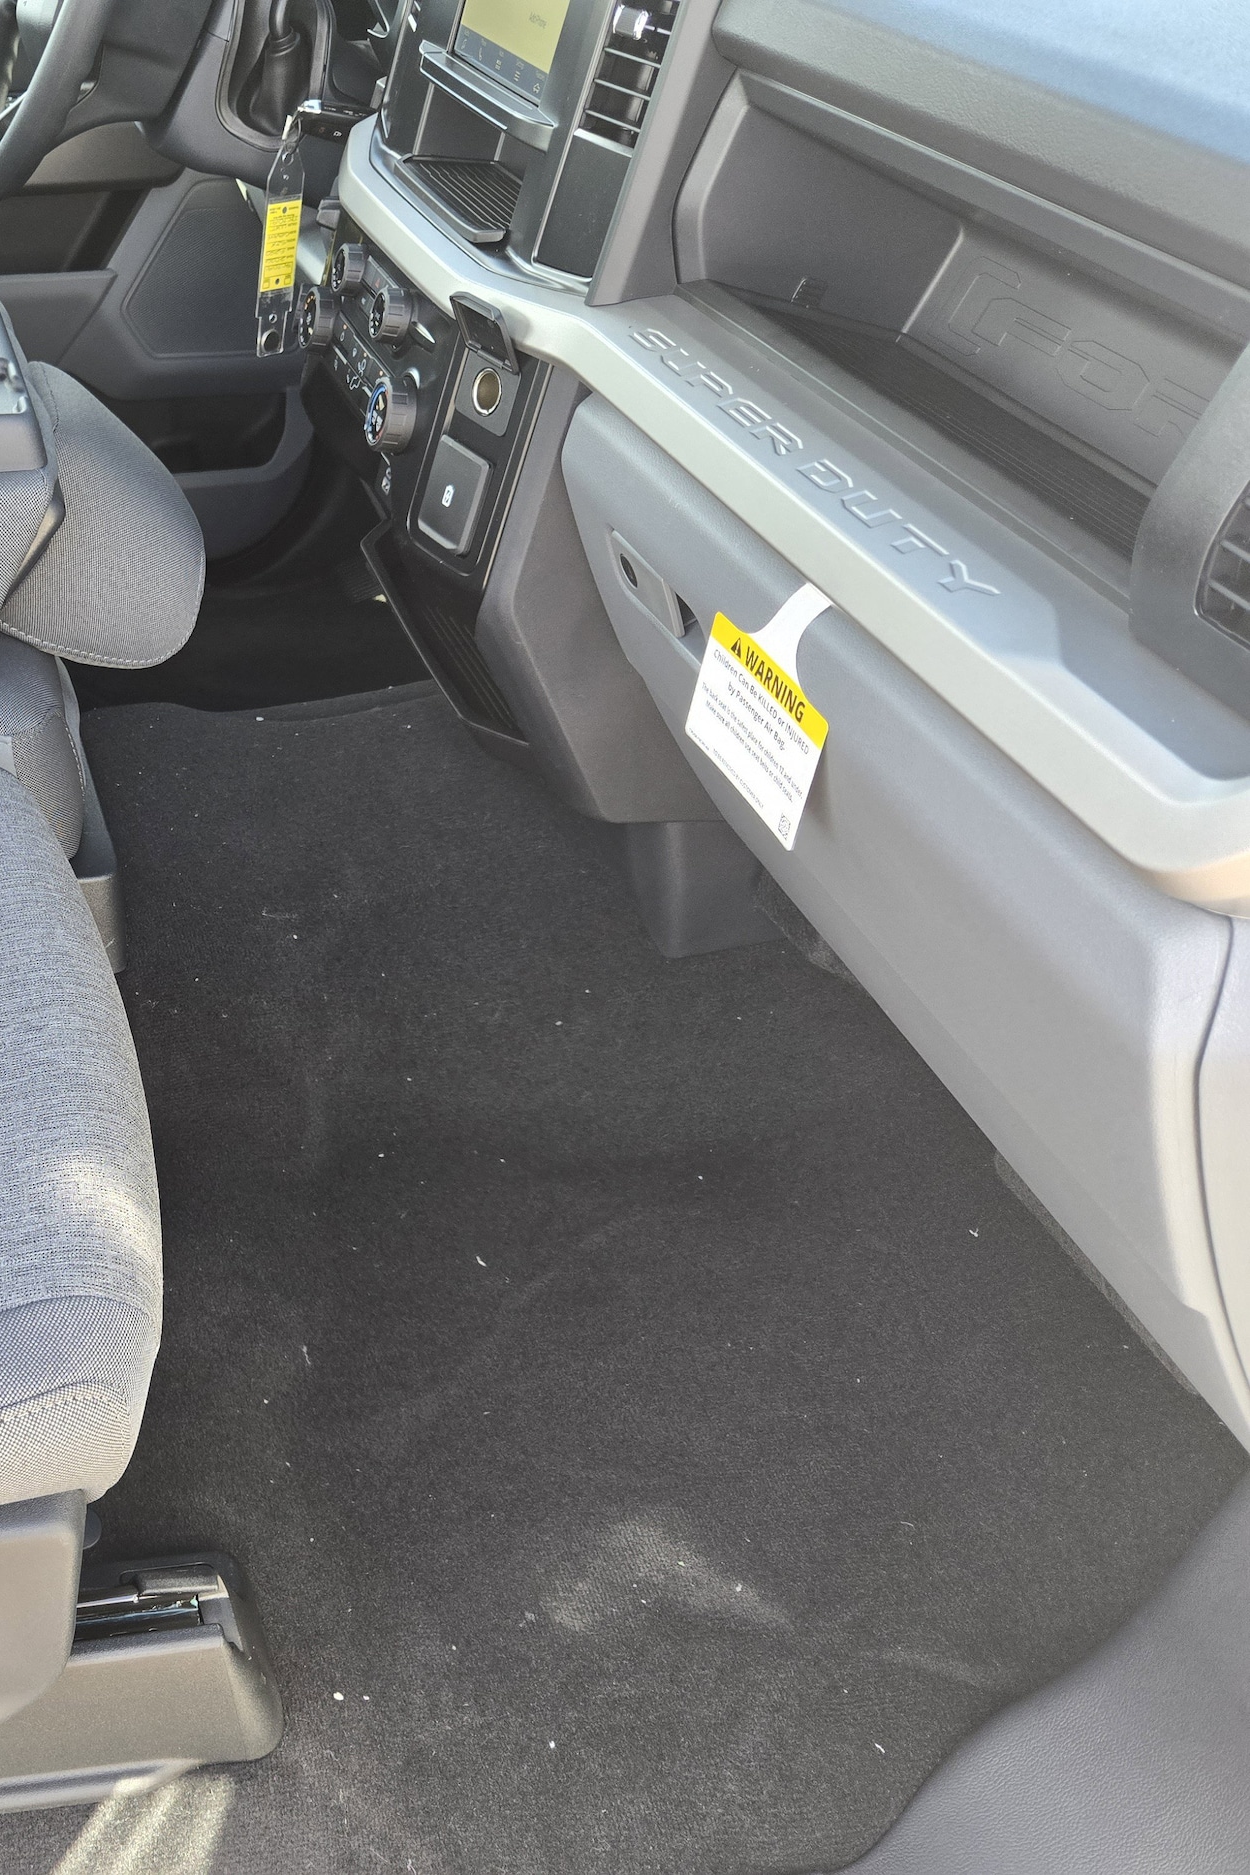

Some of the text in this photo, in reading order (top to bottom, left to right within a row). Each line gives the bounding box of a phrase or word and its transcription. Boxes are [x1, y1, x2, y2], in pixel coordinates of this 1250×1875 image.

[630, 327, 1001, 597] SUPER DUTY
[714, 647, 809, 755] Children Can Be KILLED or INJURED
[728, 681, 735, 695] by
[736, 689, 764, 726] Passenger
[764, 720, 773, 734] Air
[743, 646, 805, 724] WARNING
[764, 748, 779, 770] children
[779, 765, 784, 776] 12
